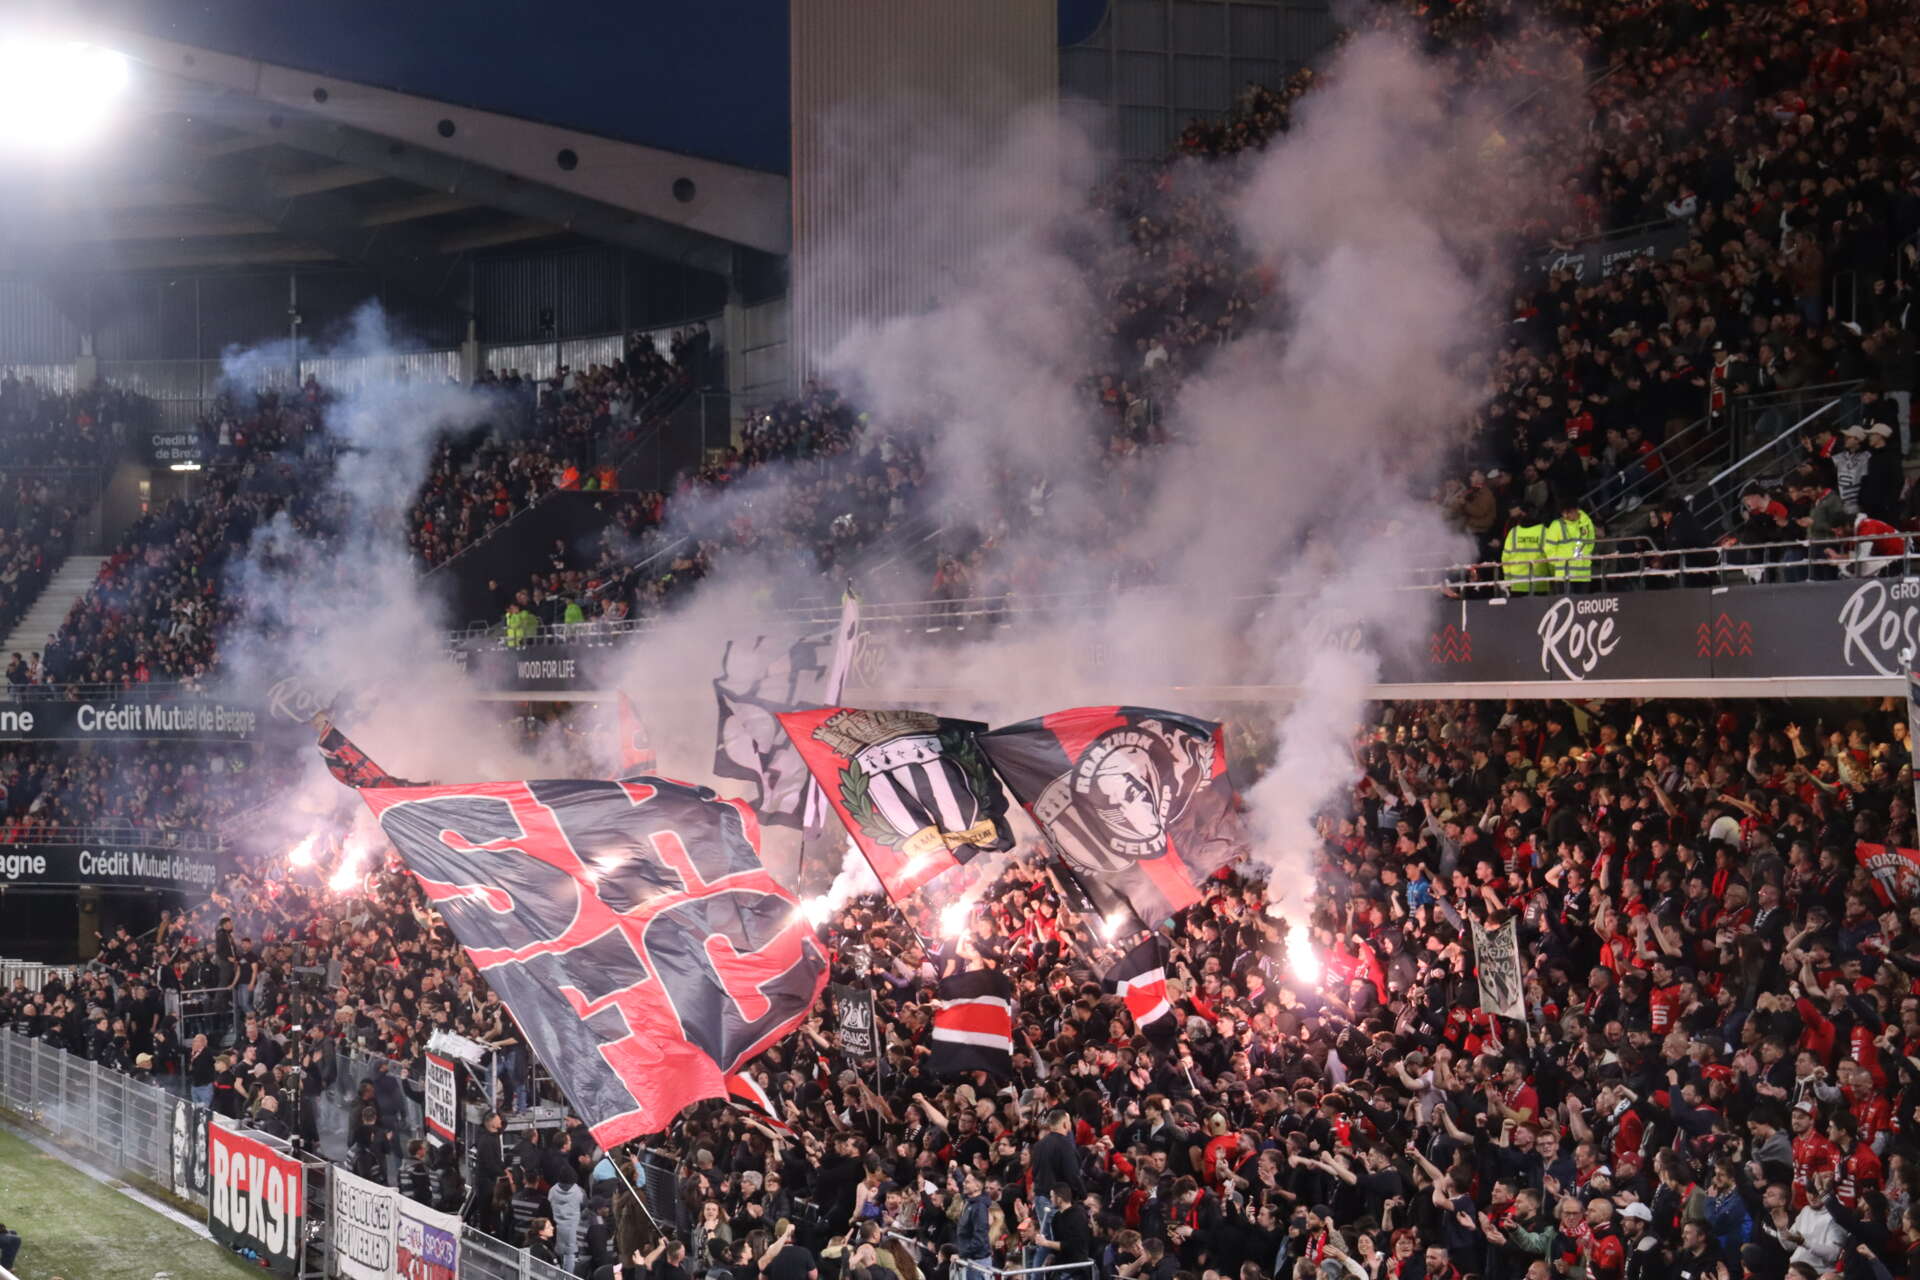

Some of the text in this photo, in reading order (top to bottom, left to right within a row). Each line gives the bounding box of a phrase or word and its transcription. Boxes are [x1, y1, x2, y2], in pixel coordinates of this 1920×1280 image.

[1576, 597, 1620, 615] GROUPE
[1537, 597, 1621, 680] Rose
[1838, 579, 1920, 676] Ros
[517, 659, 576, 681] WOOD FOR LIFE
[77, 703, 142, 732] Crédit
[145, 704, 199, 732] Mutuel
[200, 705, 214, 732] de
[215, 705, 256, 739] Bretagne
[79, 850, 129, 876] Crédit
[132, 853, 171, 878] Mutuel
[172, 856, 184, 878] de
[184, 857, 216, 890] Bretagne
